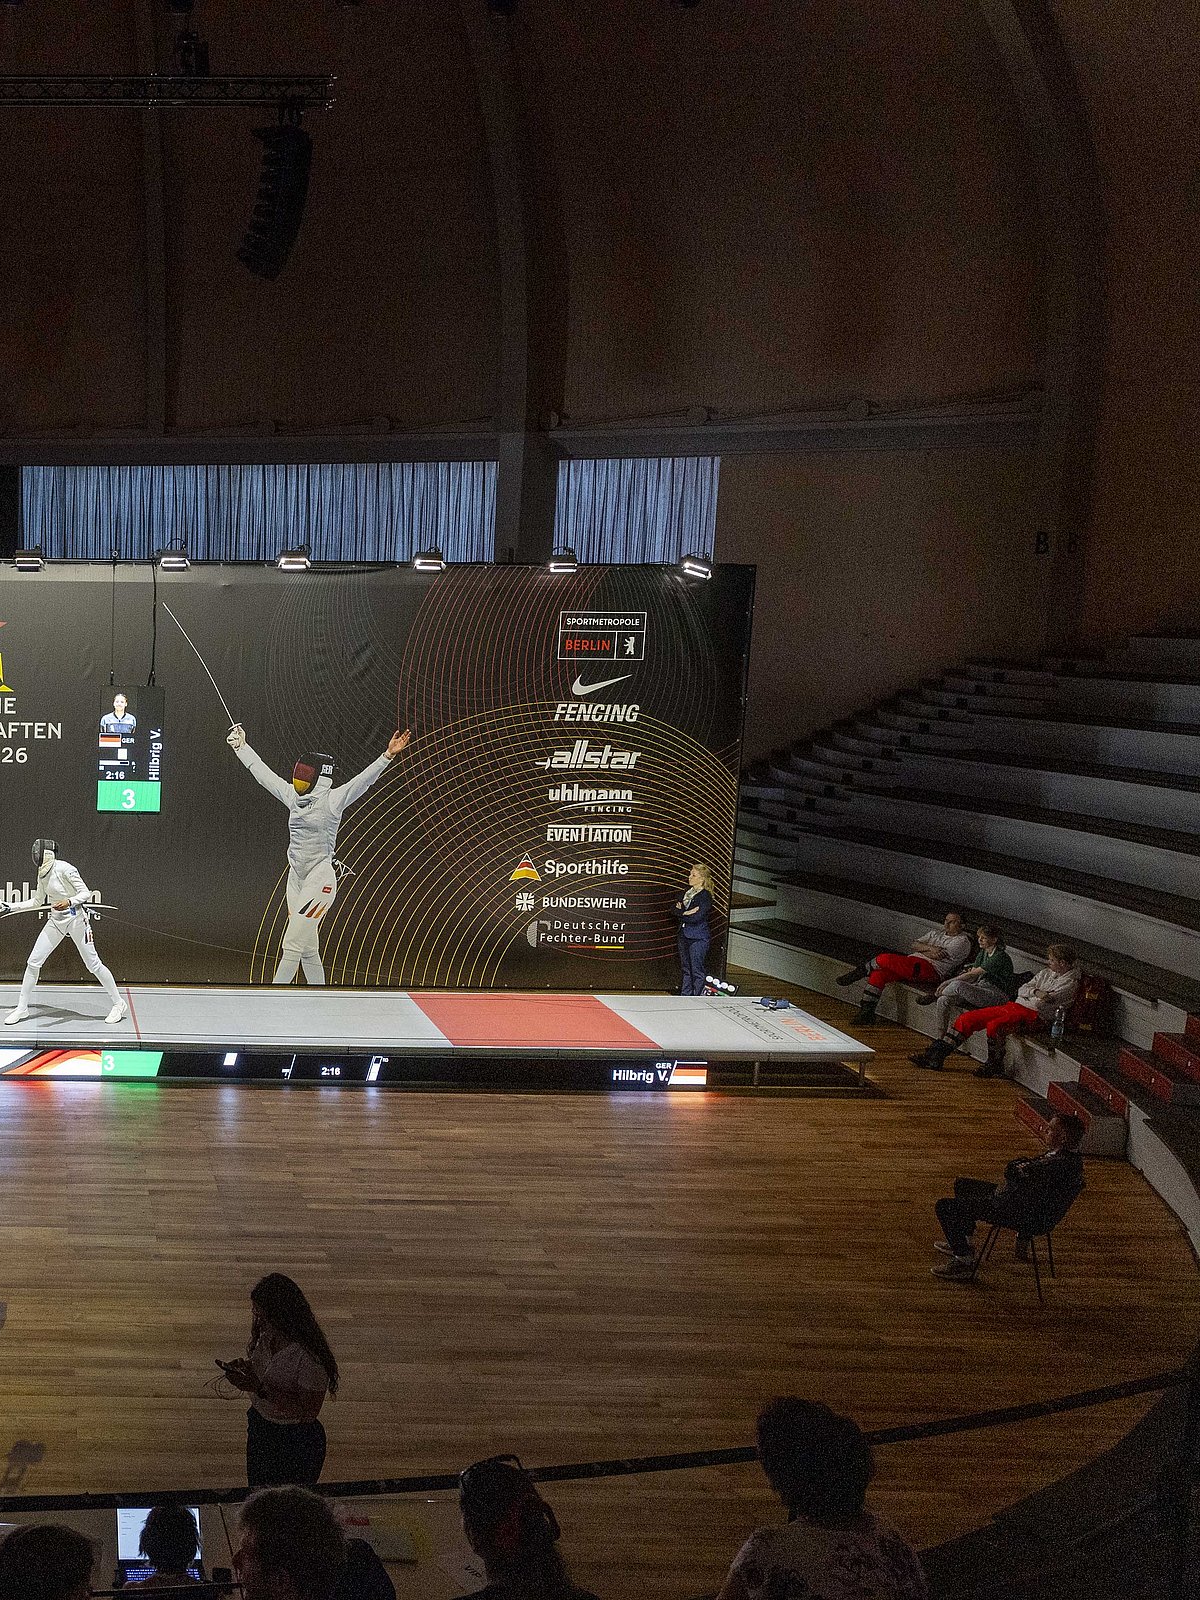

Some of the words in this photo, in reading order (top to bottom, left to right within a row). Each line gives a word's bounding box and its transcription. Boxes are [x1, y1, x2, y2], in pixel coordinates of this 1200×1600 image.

[1035, 531, 1048, 554] B
[566, 617, 640, 626] SPORTMETROPOLE
[565, 639, 611, 651] BERLIN
[554, 703, 640, 722] FENCING
[150, 728, 161, 739] V.
[148, 742, 163, 780] Hilbrig
[551, 740, 642, 769] allstar
[106, 771, 125, 779] 2:16
[122, 789, 135, 808] 3
[549, 784, 632, 801] uhlmann
[544, 860, 629, 877] Sporthilfe
[542, 897, 627, 909] BUNDESWEHR
[554, 921, 625, 930] Deutscher
[540, 932, 625, 944] Fechter-Bund
[104, 1055, 115, 1071] 3
[321, 1067, 341, 1075] 2:16
[613, 1070, 654, 1084] Hilbrig
[657, 1070, 669, 1082] V.
